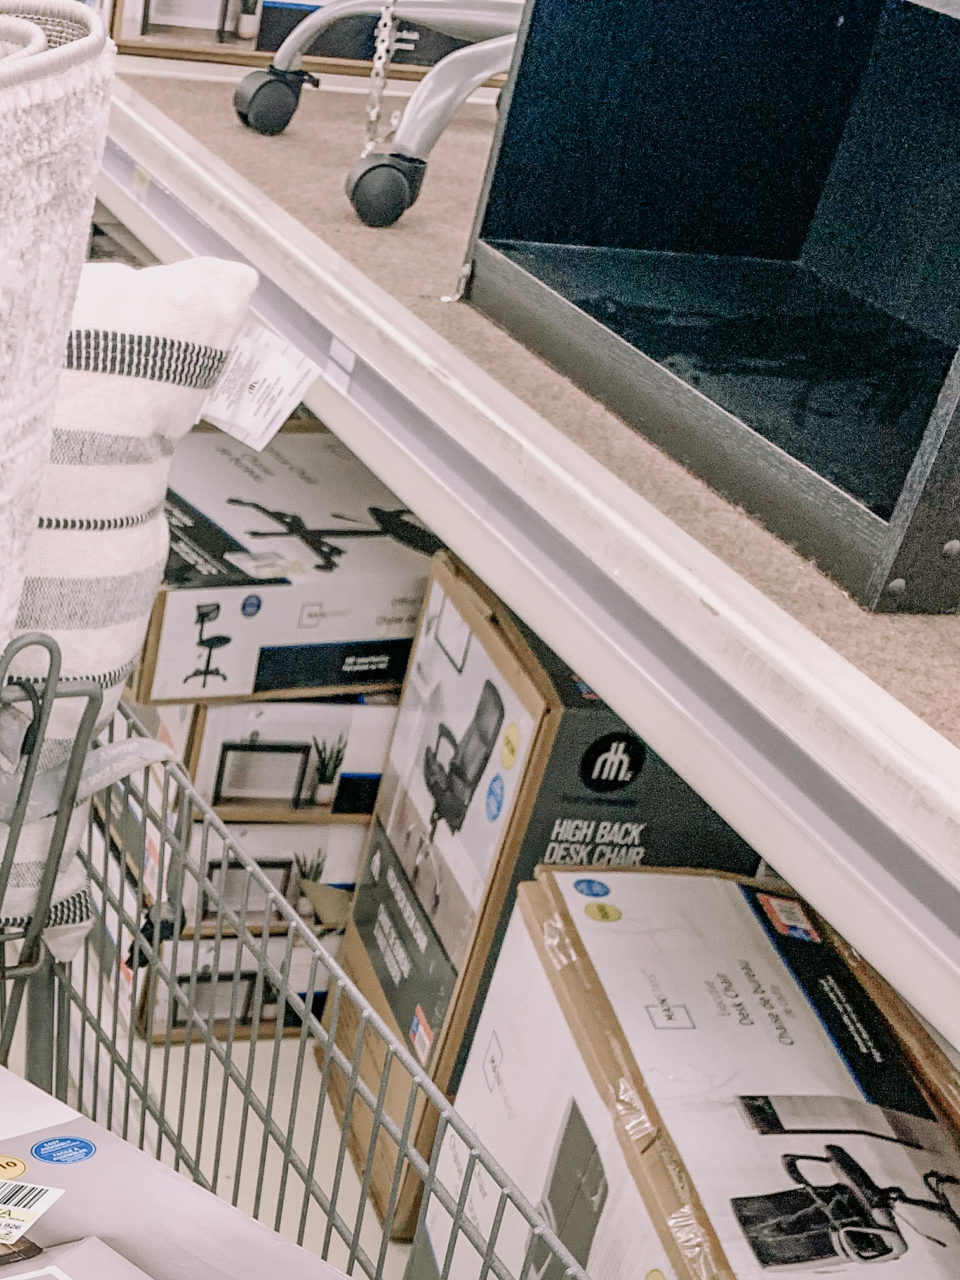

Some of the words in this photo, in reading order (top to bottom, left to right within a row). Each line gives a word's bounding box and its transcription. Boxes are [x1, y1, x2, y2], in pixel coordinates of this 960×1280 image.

[551, 818, 593, 841] HIGH
[596, 822, 646, 844] BACK
[544, 842, 592, 864] DESK
[593, 844, 646, 866] CHAIR
